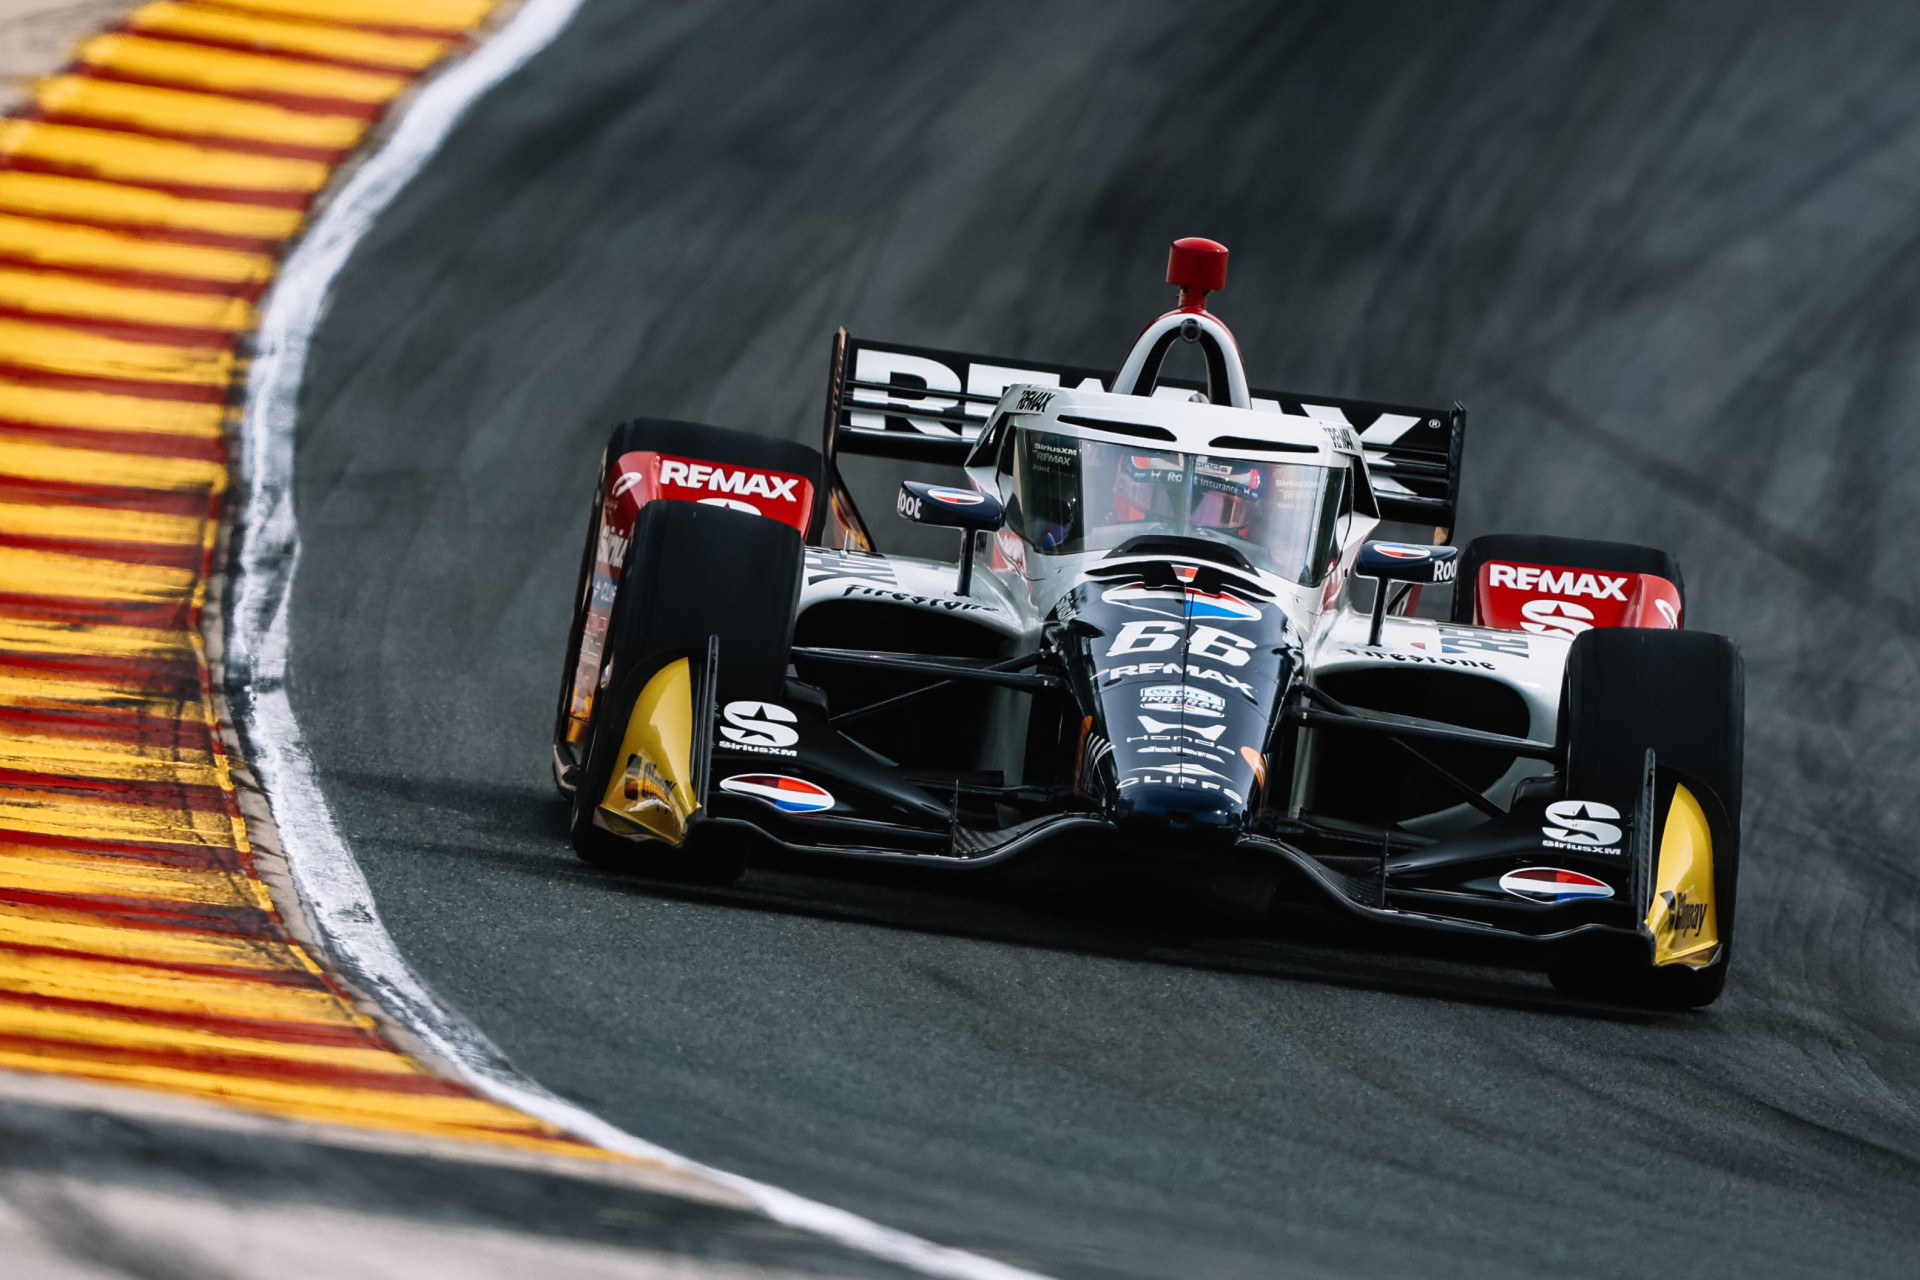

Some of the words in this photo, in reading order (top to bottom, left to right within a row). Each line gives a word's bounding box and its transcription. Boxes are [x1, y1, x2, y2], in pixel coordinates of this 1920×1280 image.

[1033, 442, 1077, 456] SiriusXM
[1036, 452, 1071, 466] REMAX
[1194, 461, 1228, 473] onda
[659, 459, 799, 502] REMAX
[1200, 478, 1239, 494] Insurance
[1489, 563, 1628, 601] REMAX
[842, 584, 999, 613] Firestone
[1106, 620, 1257, 667] 66
[1343, 649, 1496, 671] Firestone
[1109, 663, 1256, 699] REMAX
[719, 740, 797, 757] SiriusXM
[1116, 775, 1242, 804] CLIFFS
[1542, 840, 1621, 856] SiriusXM
